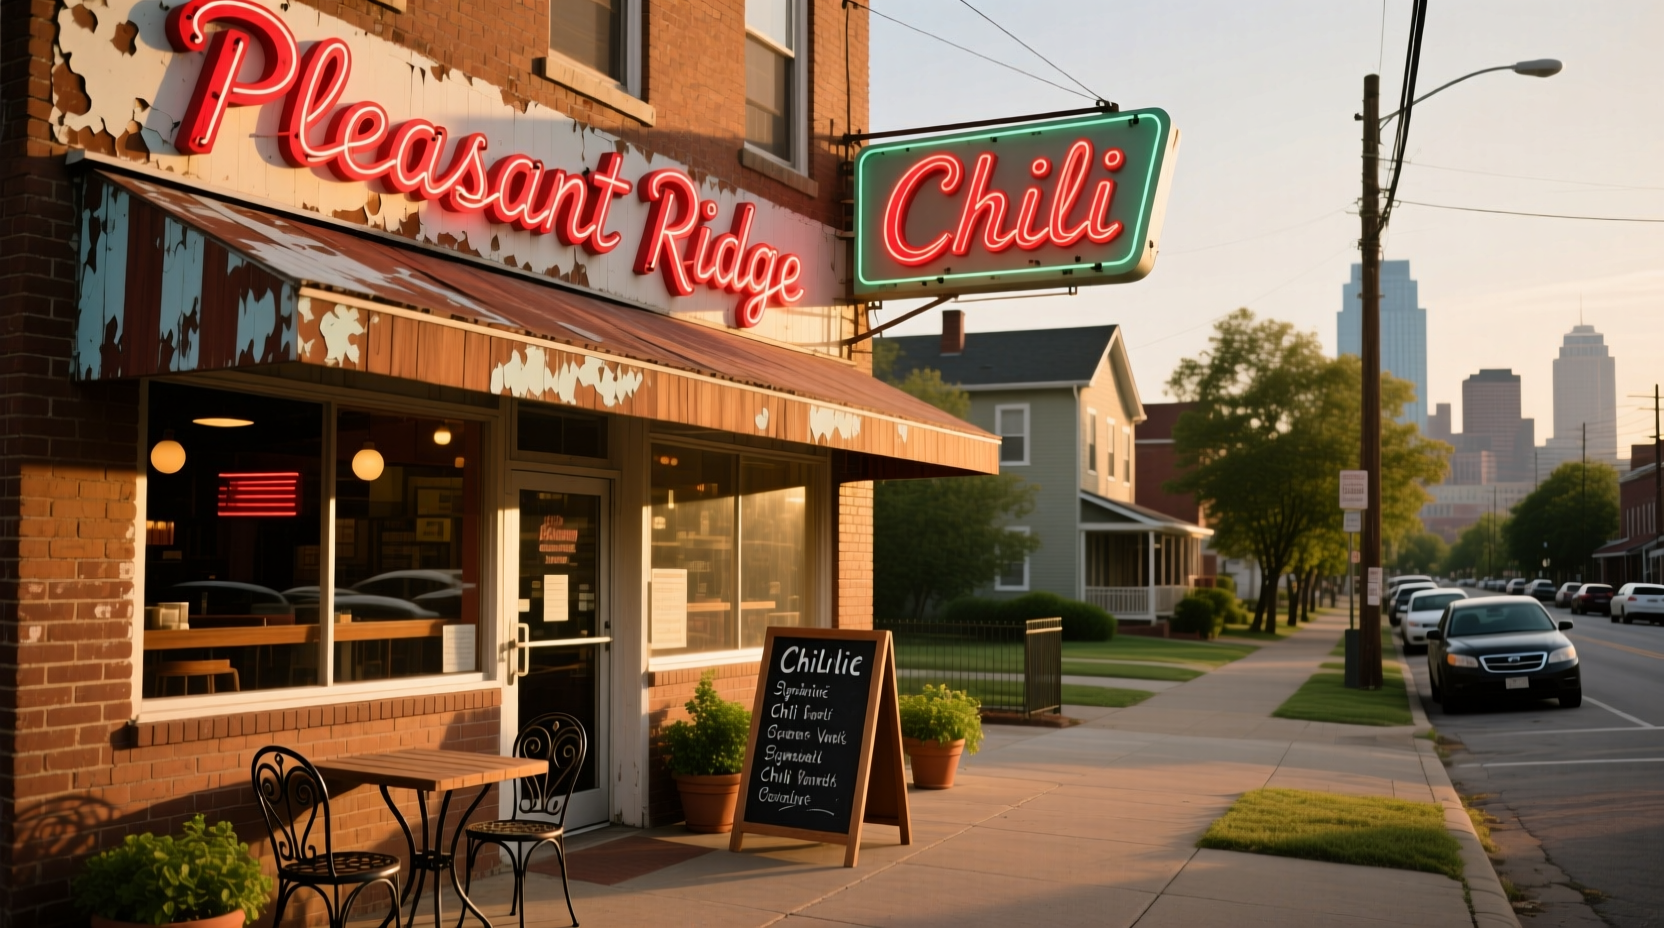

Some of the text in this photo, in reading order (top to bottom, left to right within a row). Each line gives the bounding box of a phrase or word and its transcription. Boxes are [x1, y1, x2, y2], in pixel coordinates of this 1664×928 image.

[165, 0, 804, 329] Pleasant Ridge
[884, 137, 1124, 267] Chili
